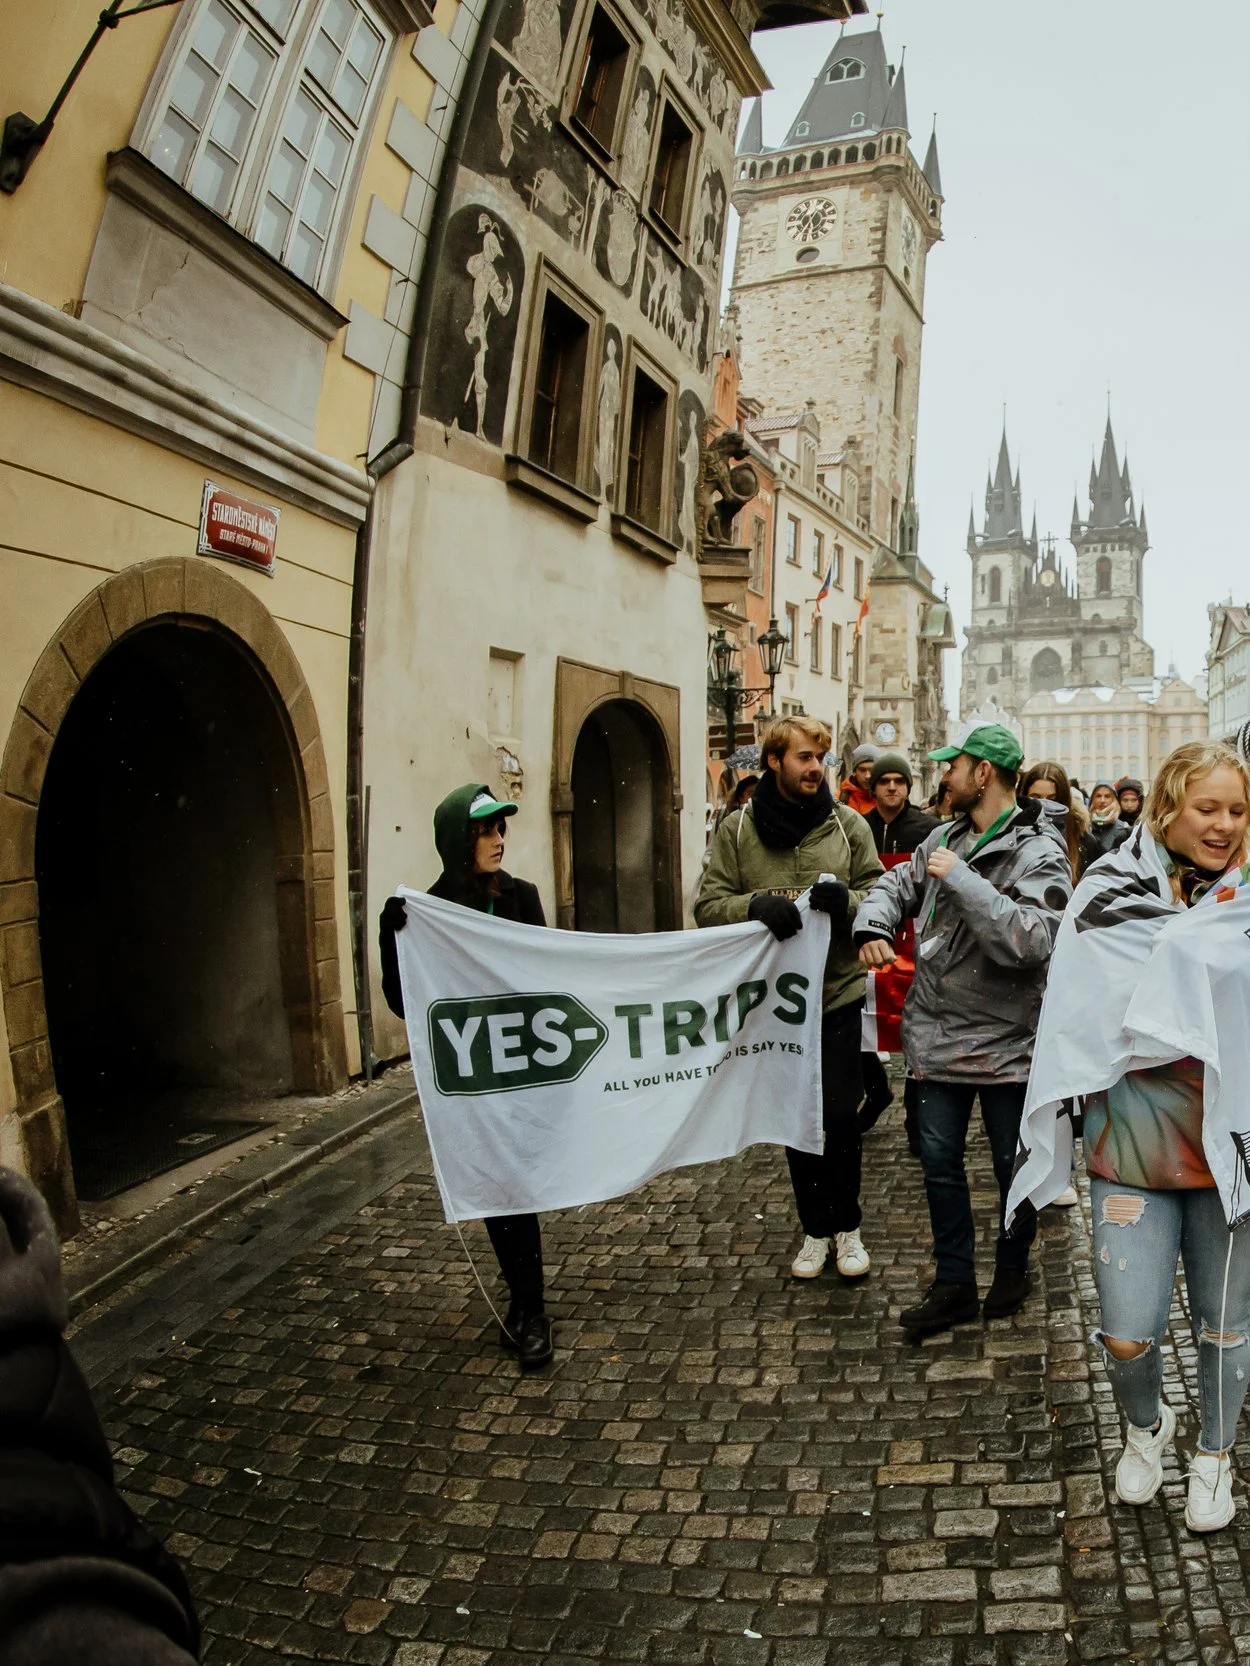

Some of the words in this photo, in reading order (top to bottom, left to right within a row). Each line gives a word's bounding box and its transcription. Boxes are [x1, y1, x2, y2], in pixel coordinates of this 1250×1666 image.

[614, 972, 809, 1059] TRIPS
[603, 1081, 629, 1092] ALL
[633, 1074, 661, 1088] YOU
[665, 1067, 702, 1083] HAVE
[735, 1045, 749, 1057] IS
[752, 1040, 776, 1054] SAY
